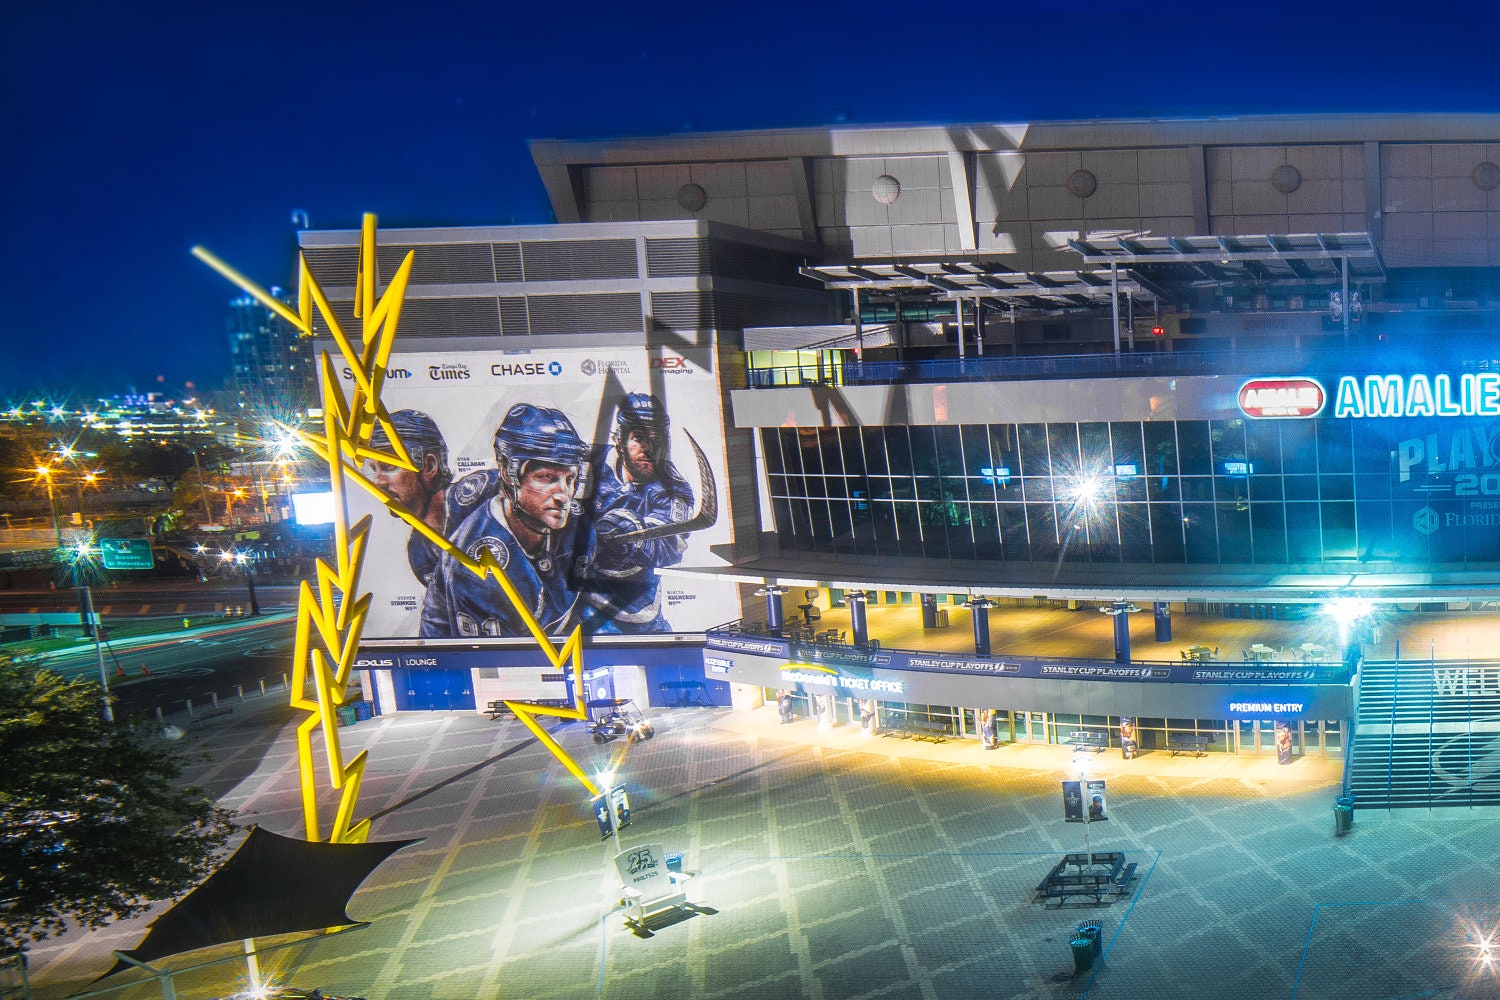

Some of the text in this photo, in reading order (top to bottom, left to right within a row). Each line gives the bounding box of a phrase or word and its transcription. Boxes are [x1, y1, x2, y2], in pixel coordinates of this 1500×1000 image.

[597, 360, 628, 368] FLORIDA
[650, 356, 687, 369] DEX
[428, 365, 471, 381] Times
[491, 363, 545, 376] CHASE
[597, 366, 632, 375] HOSPITAL
[1335, 374, 1500, 418] AMALIE
[797, 649, 823, 659] STANLEY
[823, 651, 836, 659] CUP
[836, 652, 868, 662] PLAYOFFS
[405, 658, 437, 666] LOUNGE
[909, 659, 940, 668] STANLEY
[940, 660, 957, 669] CUP
[956, 662, 994, 671] PLAYOFFS
[1043, 666, 1140, 676] STANLEY CUP PLAYOFFS
[1195, 671, 1302, 679] STANLEY CUP PLAYOFFS
[838, 676, 870, 690] TICKET
[870, 679, 905, 693] OFFICE
[1229, 702, 1304, 713] PREMIUM ENTRY
